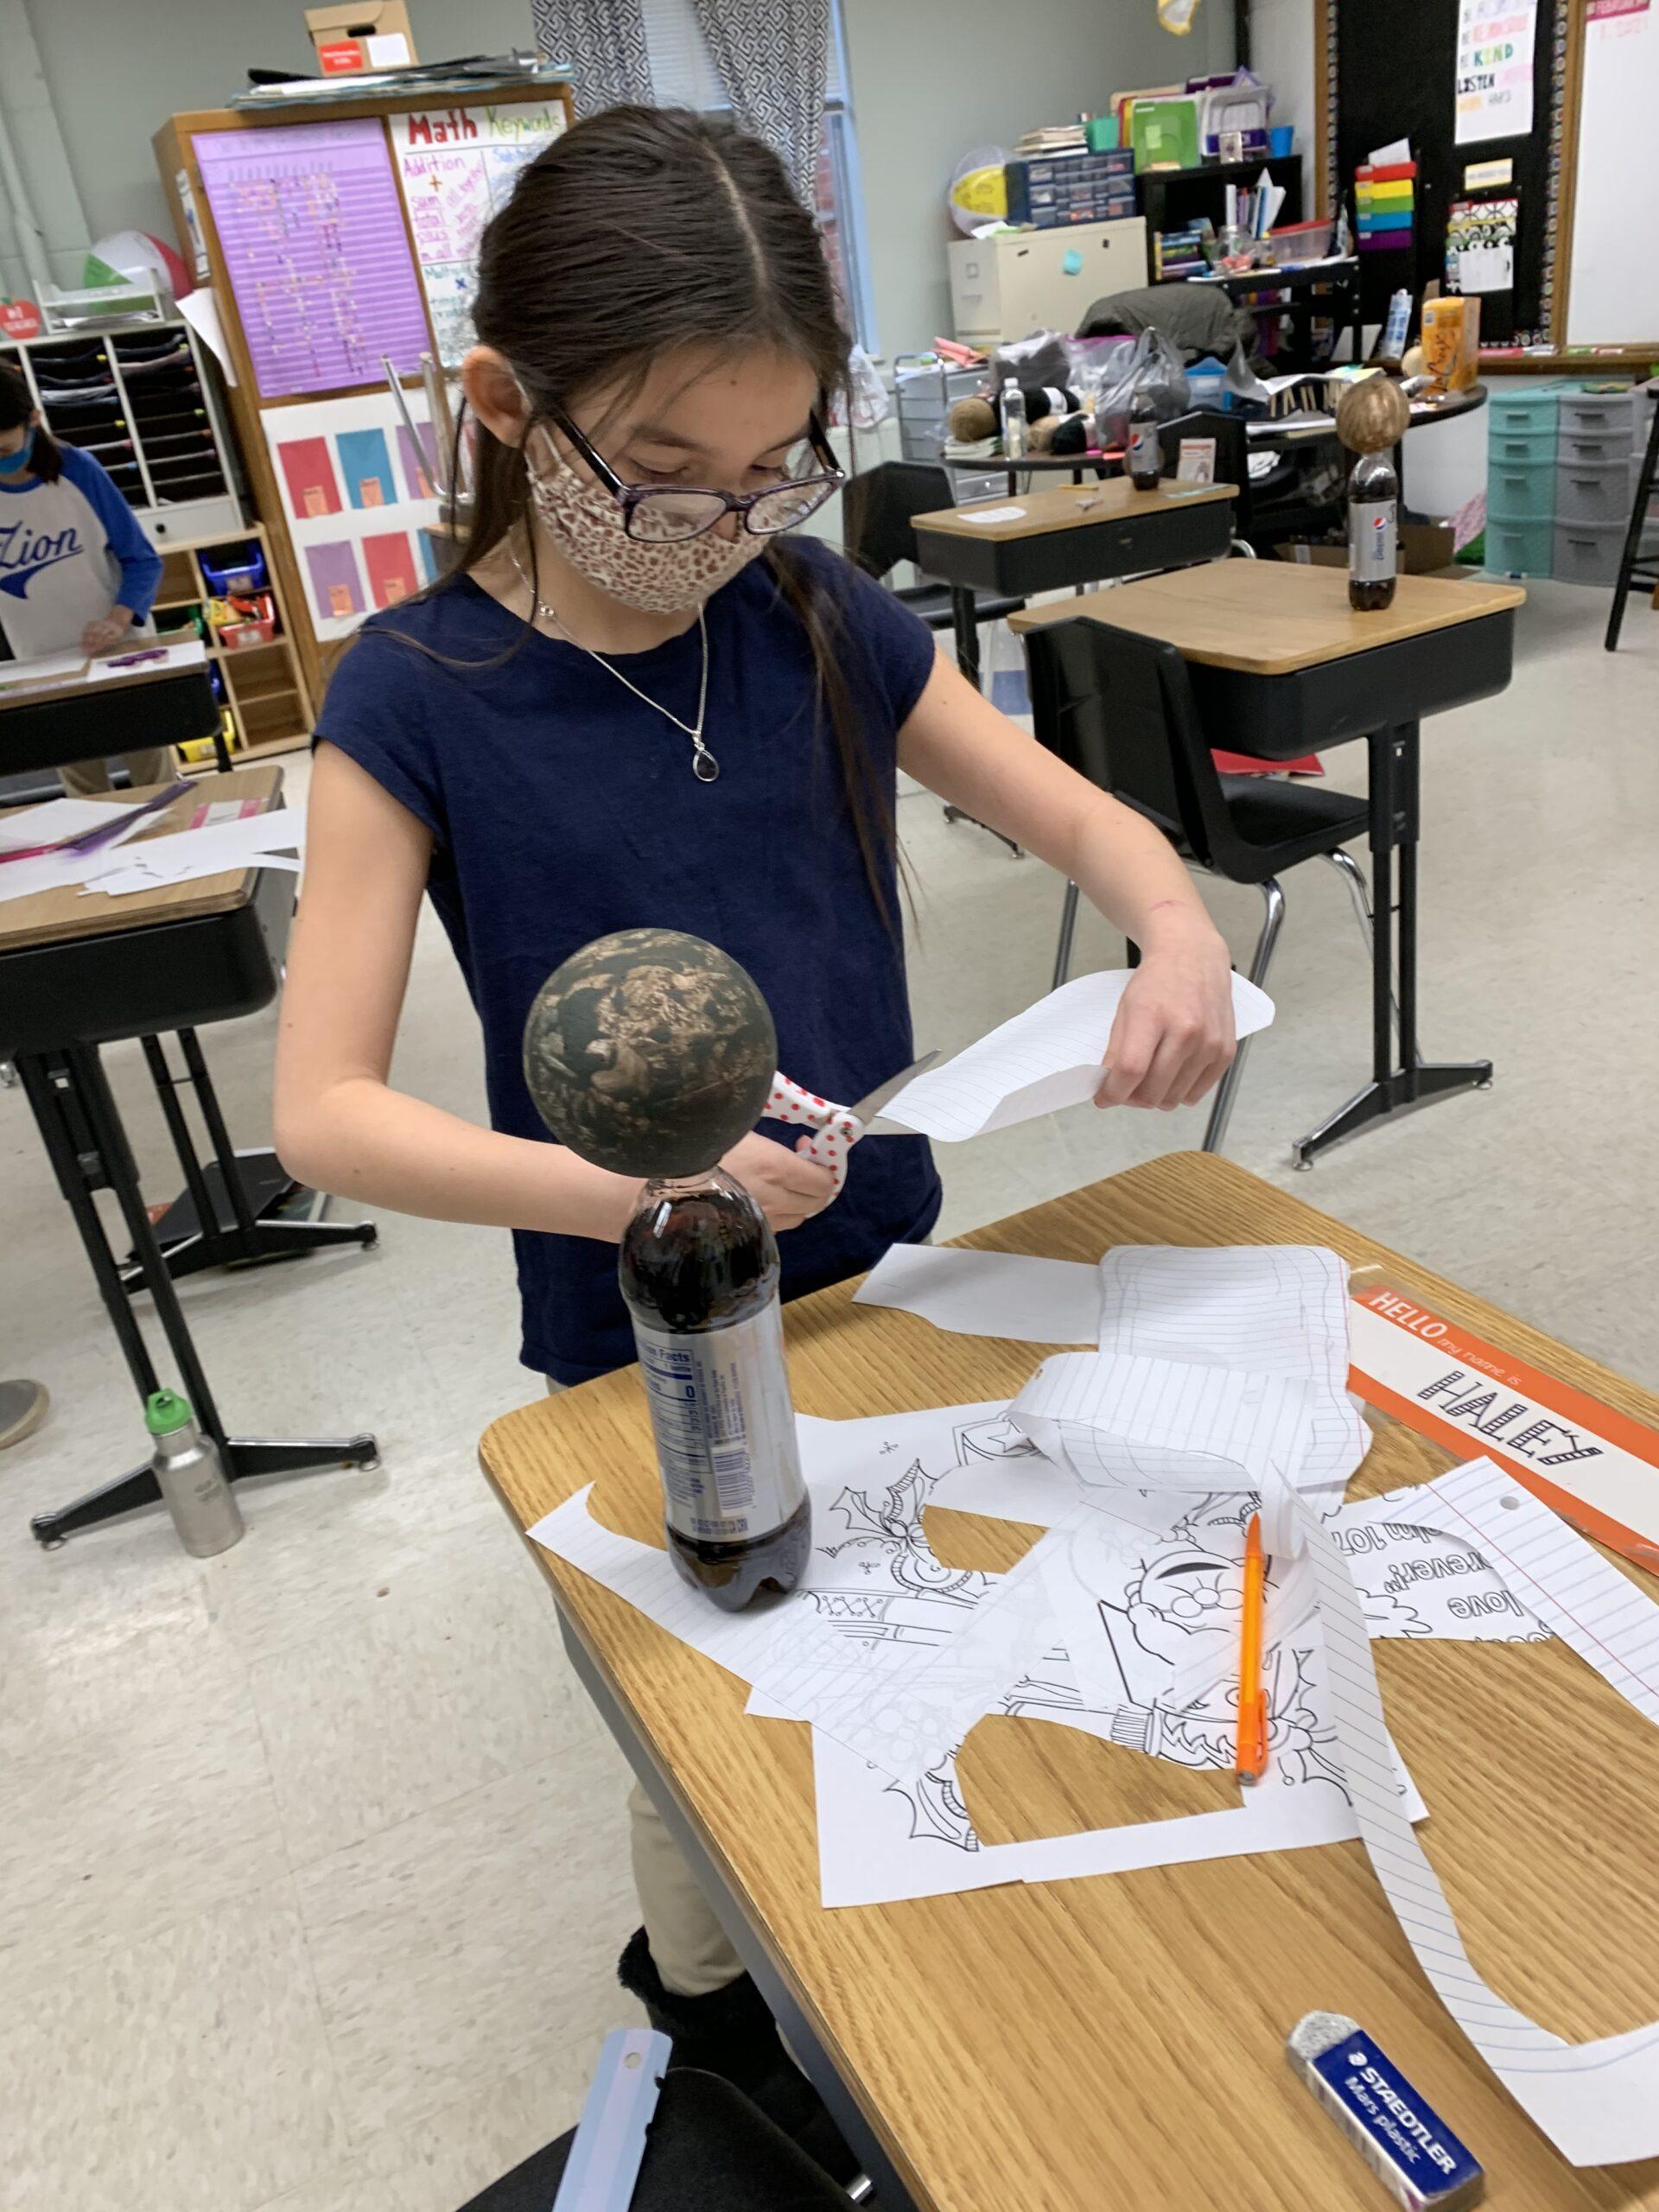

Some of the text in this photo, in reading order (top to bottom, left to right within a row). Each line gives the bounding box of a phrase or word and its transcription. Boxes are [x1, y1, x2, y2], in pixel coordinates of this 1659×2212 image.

[1474, 43, 1514, 67] KIND
[409, 106, 478, 145] Math
[403, 154, 467, 177] Addition
[0, 520, 83, 569] Zion
[1368, 1291, 1531, 1387] HELLO my name is
[685, 1384, 696, 1399] 0
[1417, 1370, 1605, 1466] HALEY
[1447, 1590, 1524, 1619] love
[1344, 2075, 1421, 2164] Mars plastic
[1359, 2066, 1457, 2176] STAEDTLER
